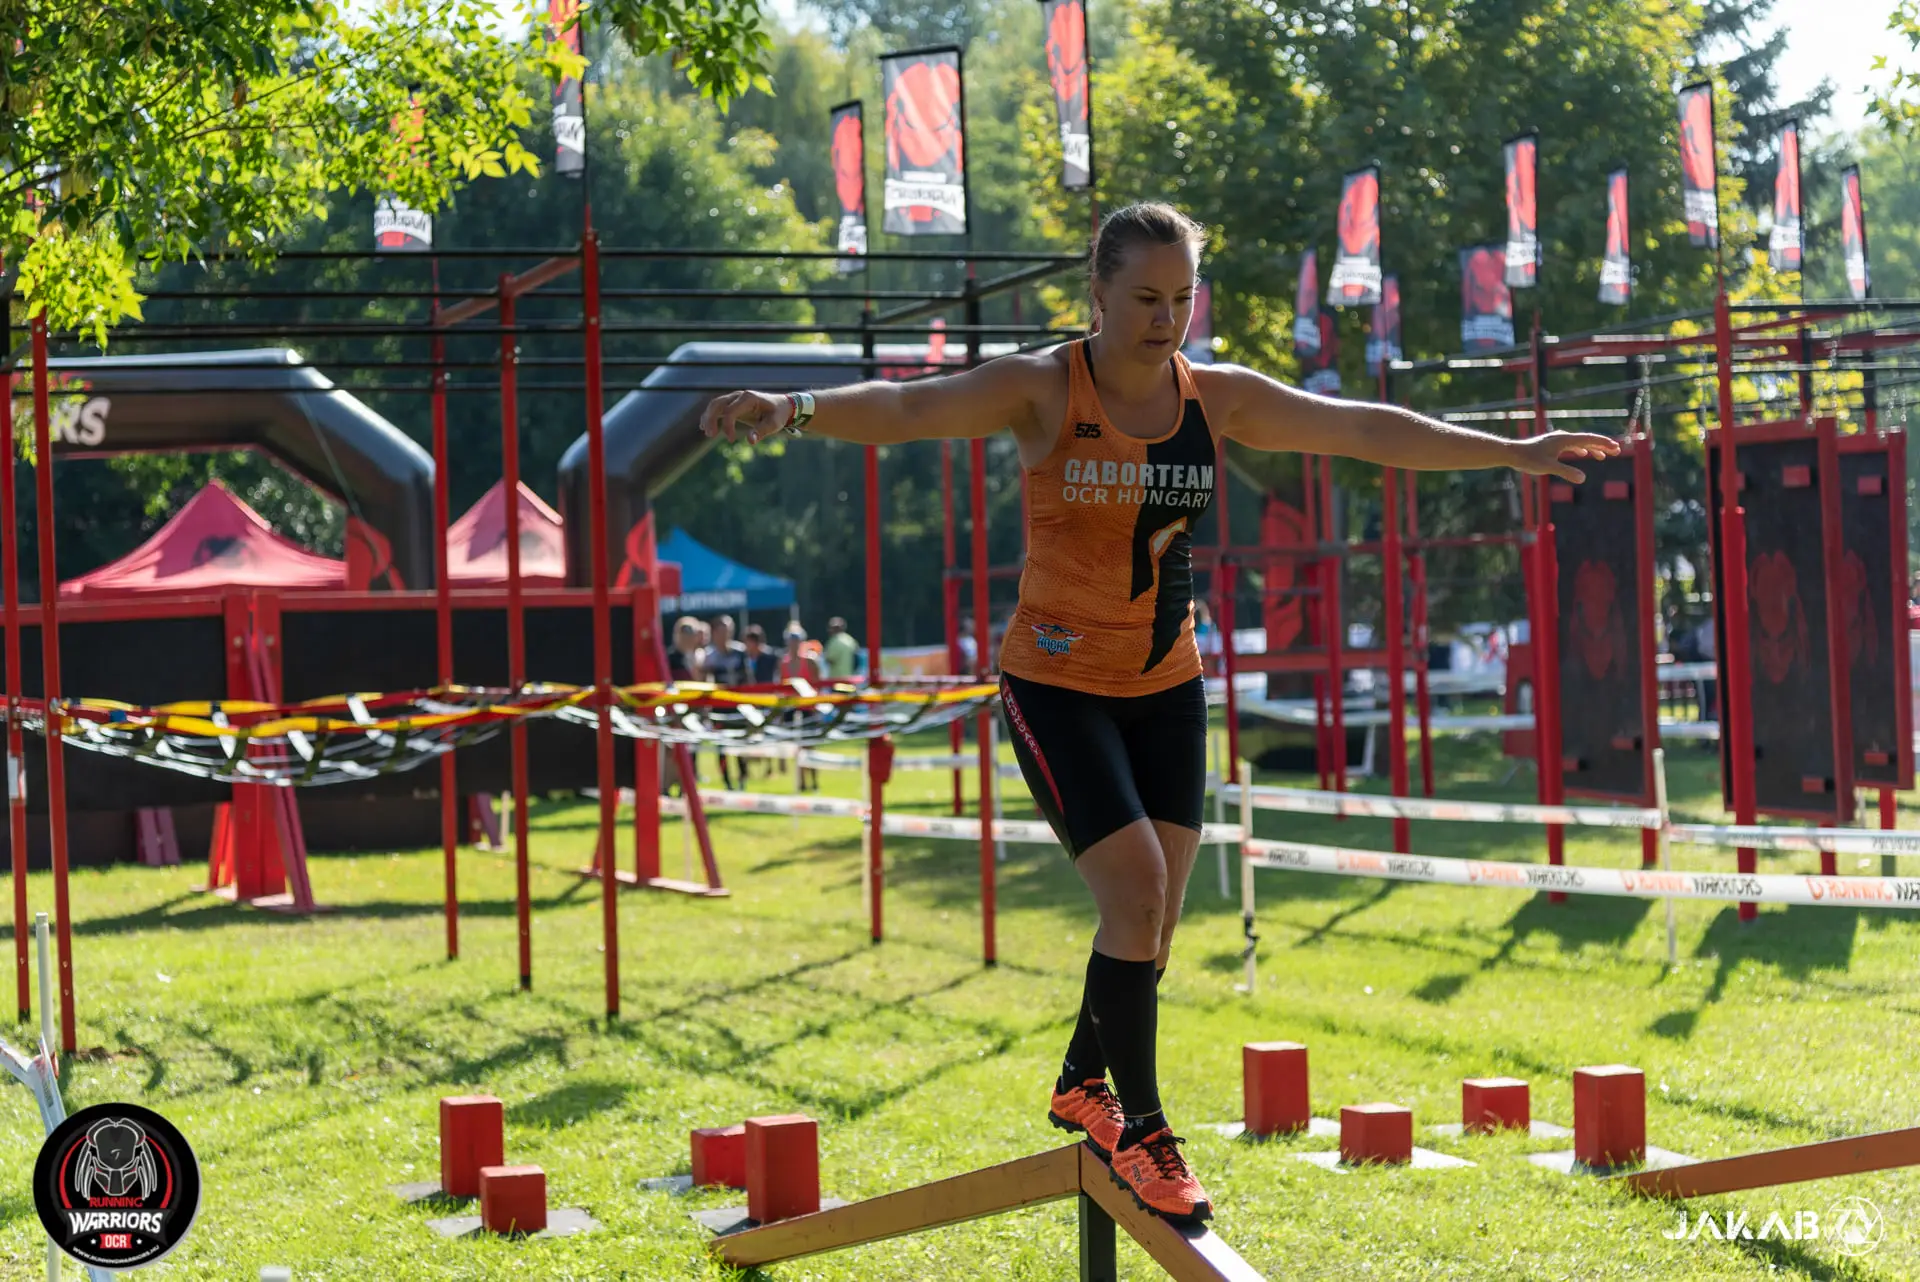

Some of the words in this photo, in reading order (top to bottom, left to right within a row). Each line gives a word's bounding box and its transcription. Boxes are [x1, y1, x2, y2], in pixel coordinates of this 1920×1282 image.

[1064, 458, 1214, 489] GABORTEAM
[1062, 485, 1109, 504] OCR
[1116, 487, 1212, 508] HUNGARY
